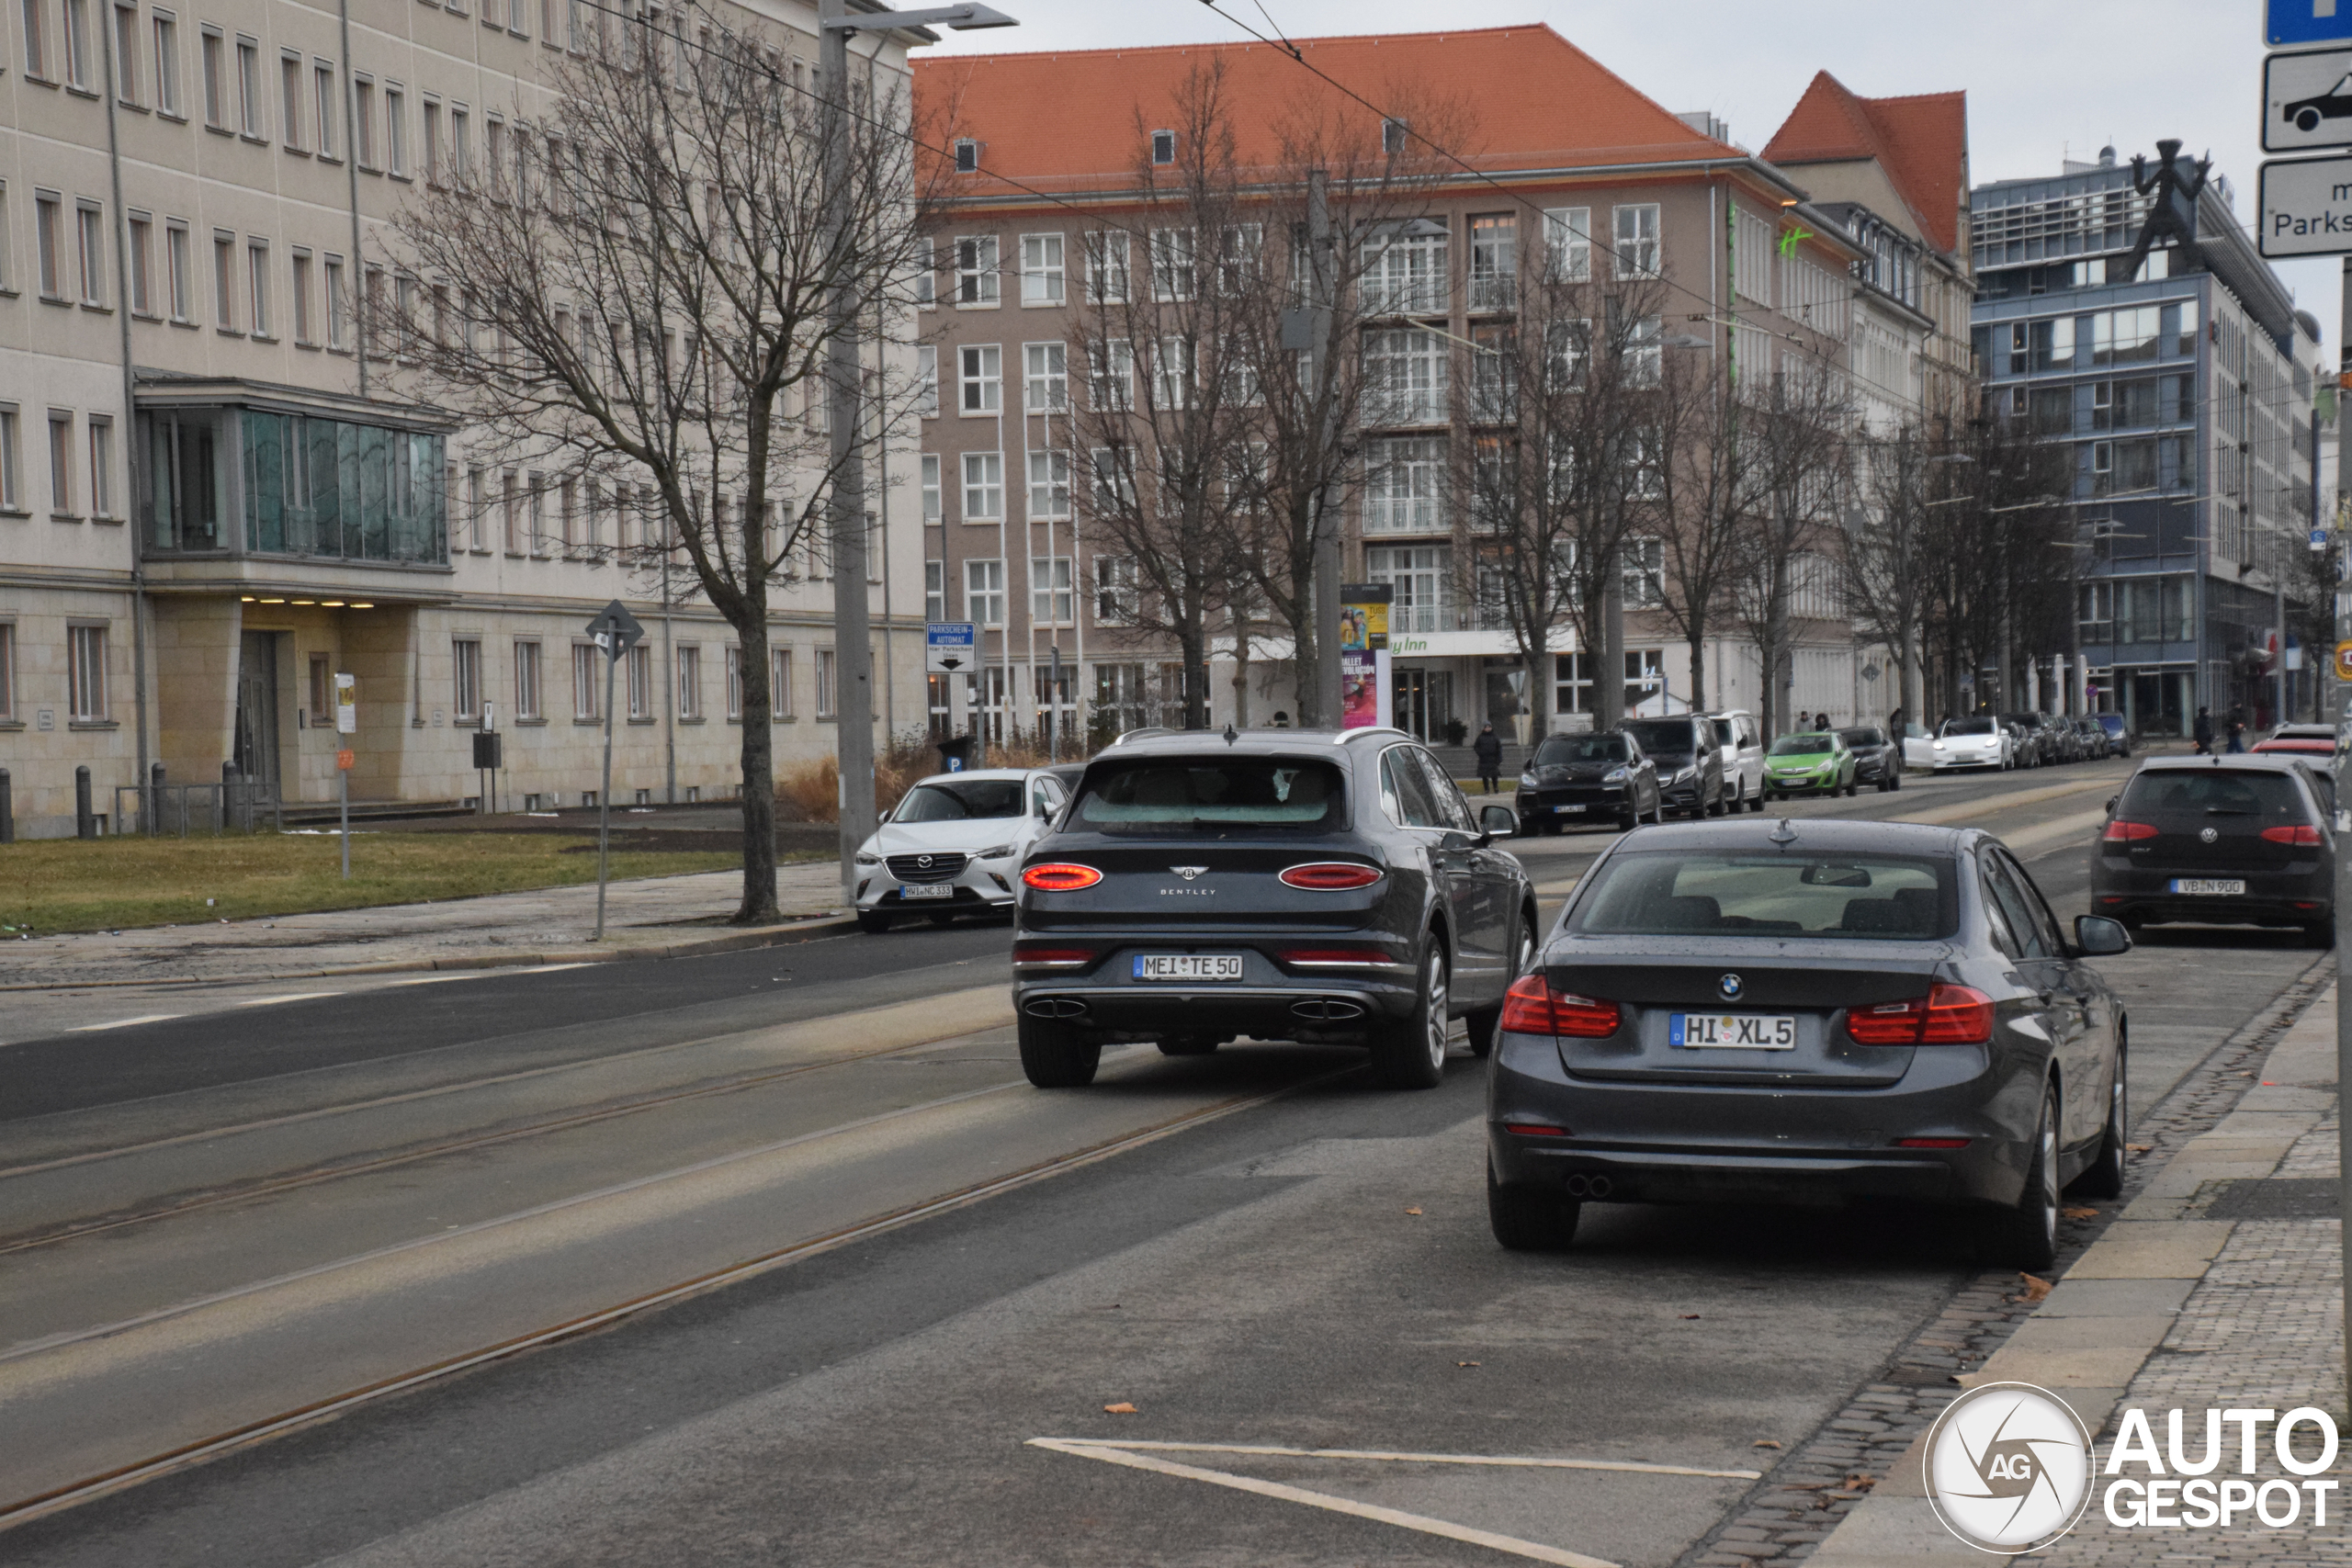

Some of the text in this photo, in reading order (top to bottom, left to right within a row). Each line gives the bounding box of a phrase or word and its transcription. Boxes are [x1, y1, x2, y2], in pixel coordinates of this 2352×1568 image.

[2275, 210, 2352, 237] Parks
[929, 626, 972, 634] PARKSCHEIN-
[937, 636, 965, 644] AUTOMAT
[1391, 642, 1402, 655] y
[1404, 637, 1428, 650] Inn
[951, 758, 960, 773] P
[924, 886, 934, 896] NC
[936, 886, 951, 895] 333
[2183, 882, 2241, 893] VB N 900
[1145, 957, 1177, 975] MEI
[1191, 957, 1213, 975] TE
[1216, 957, 1239, 975] 50
[1686, 1017, 1718, 1043] HI
[1737, 1019, 1771, 1044] XL
[1776, 1020, 1792, 1045] 5
